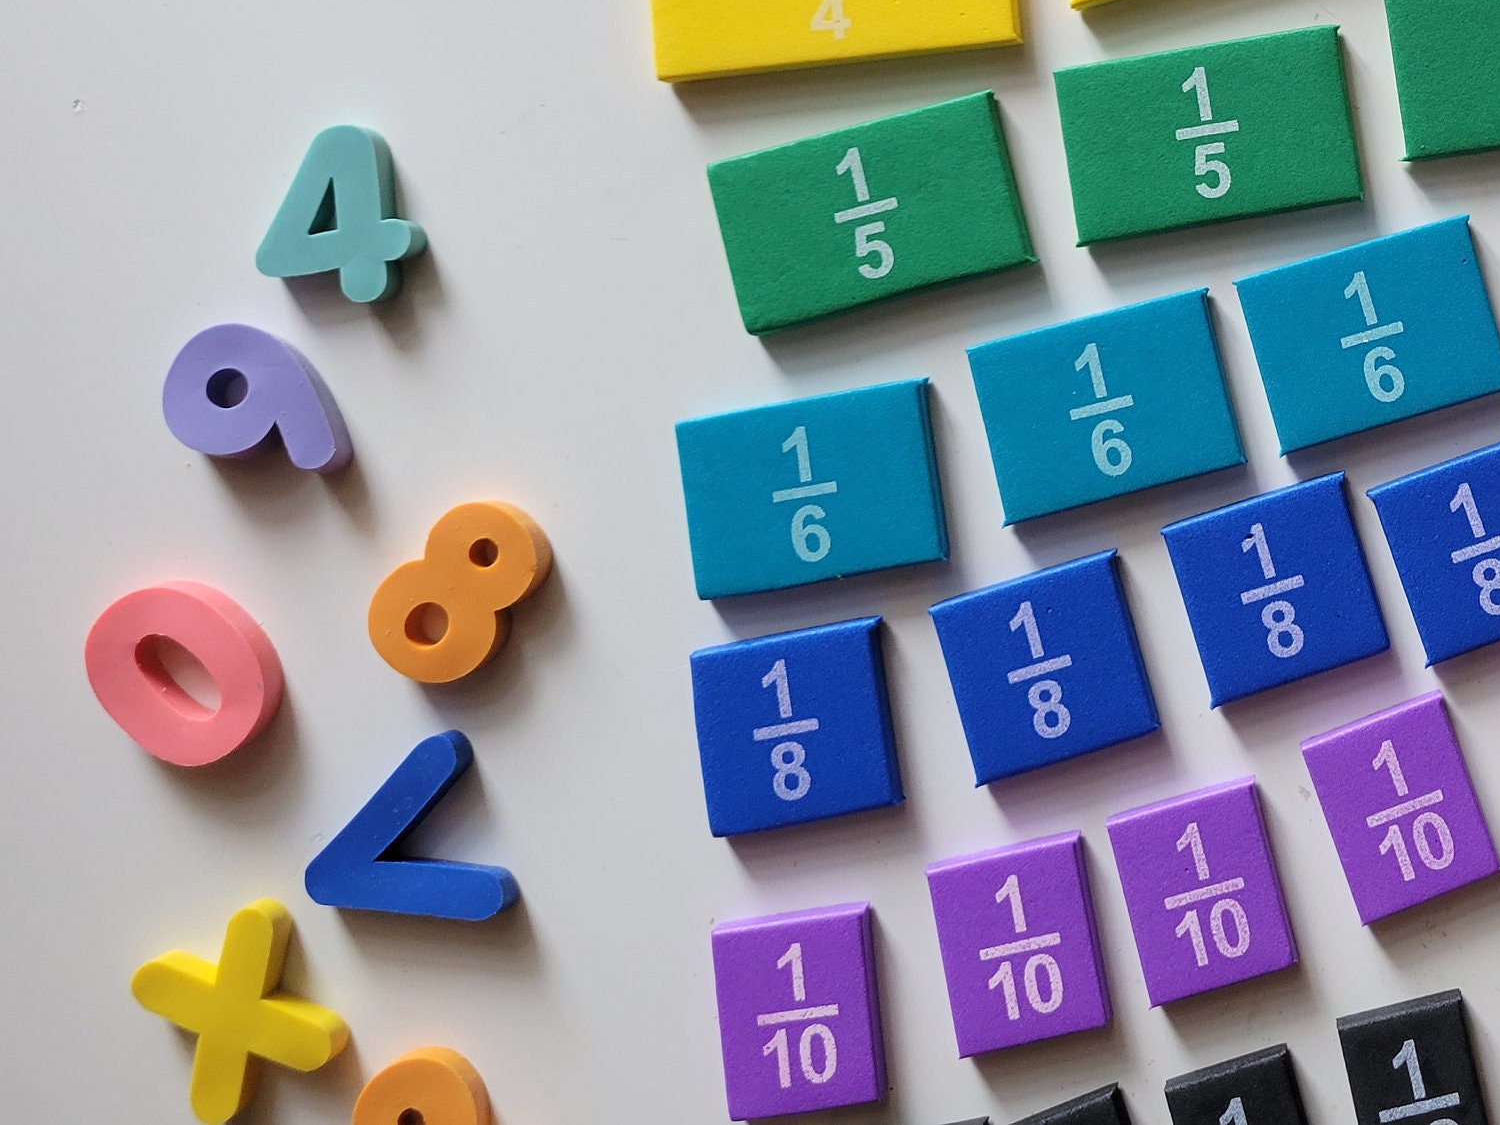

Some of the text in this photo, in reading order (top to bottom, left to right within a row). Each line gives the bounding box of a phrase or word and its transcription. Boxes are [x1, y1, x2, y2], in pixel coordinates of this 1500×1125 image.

[1181, 66, 1213, 122] 1
[835, 146, 871, 203] 1
[1194, 141, 1232, 199] 5
[255, 124, 428, 303] 4
[854, 220, 895, 279] 5
[1343, 270, 1379, 327] 1
[1074, 342, 1108, 399] 1
[1363, 345, 1406, 403] 6
[781, 425, 813, 483] 1
[1091, 418, 1133, 478] 6
[790, 504, 832, 563] 6
[1449, 482, 1487, 539] 1
[1241, 522, 1277, 580] 1
[368, 501, 553, 684] 8
[1008, 600, 1045, 660] 1
[1260, 599, 1305, 659] 8
[761, 658, 793, 719] 1
[1027, 679, 1071, 739] 8
[770, 740, 812, 802] 8
[1372, 739, 1409, 797] 1
[1175, 821, 1210, 881] 1
[1378, 811, 1455, 882] 10
[994, 874, 1028, 934] 1
[1175, 898, 1251, 967] 10
[776, 942, 806, 1002] 1
[988, 953, 1064, 1021] 10
[762, 1023, 838, 1089] 10
[1392, 1038, 1427, 1101] 1
